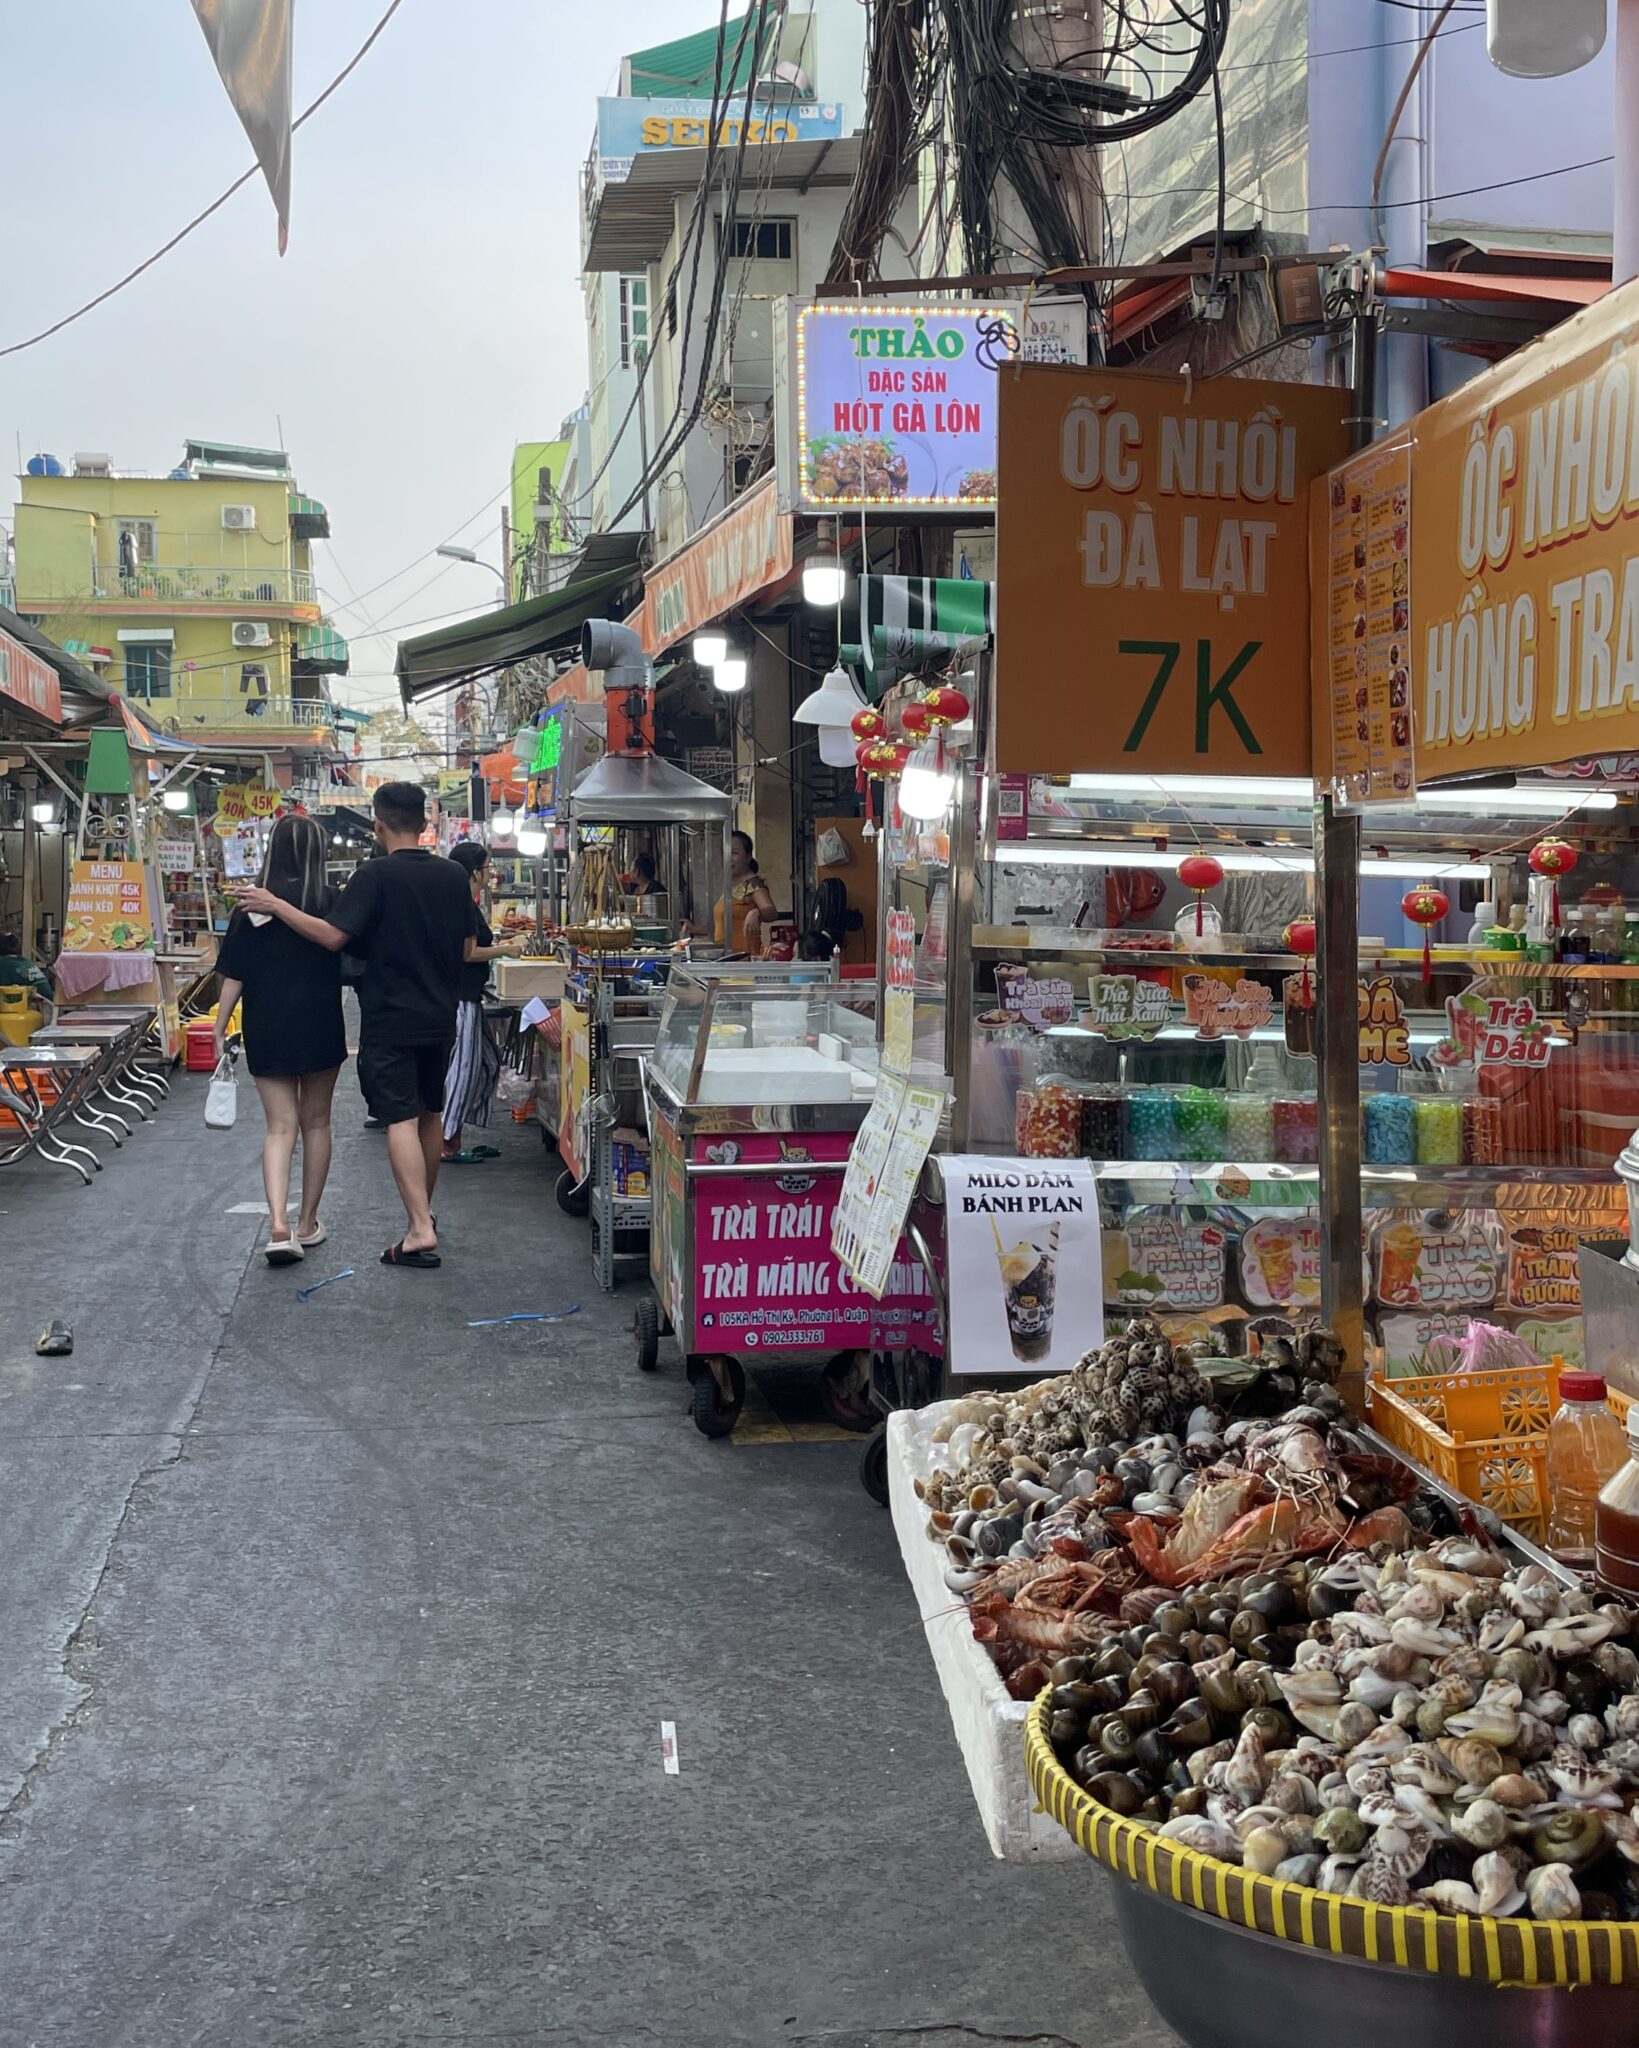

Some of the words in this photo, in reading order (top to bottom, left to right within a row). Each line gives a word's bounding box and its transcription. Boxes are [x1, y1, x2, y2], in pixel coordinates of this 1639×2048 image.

[850, 317, 964, 359] THẢO
[868, 367, 905, 397] ĐẶC
[912, 366, 947, 393] SẢN
[834, 397, 884, 438] HỘT
[893, 399, 926, 433] GÀ
[935, 398, 980, 439] LỘN
[1062, 394, 1141, 493] ỐC
[1159, 405, 1297, 502] NHỒI
[1459, 402, 1515, 571] ỐC
[1080, 500, 1162, 588] ĐÀ
[1182, 515, 1278, 611] LẠT
[1424, 583, 1536, 745] HỒNG
[1118, 639, 1263, 754] 7K
[223, 801, 247, 819] 40K
[251, 795, 274, 810] 45K
[91, 865, 123, 879] MENU
[121, 884, 140, 896] 45K
[121, 901, 140, 914] 40K
[1005, 978, 1037, 996] Trà
[1040, 977, 1073, 995] Sữa
[1099, 983, 1132, 1005] Trà
[1134, 983, 1173, 1003] Sữa
[1488, 1000, 1534, 1028] Trà
[967, 1173, 1021, 1188] MILO
[962, 1193, 1023, 1213] BÁNH
[1028, 1196, 1083, 1213] PLAN
[711, 1199, 757, 1241] TRÀ
[766, 1198, 823, 1239] TRÁI
[1421, 1225, 1493, 1266] TRÀ
[702, 1257, 749, 1299] TRÀ
[757, 1256, 831, 1297] MÃNG
[1524, 1254, 1571, 1279] TRÂN
[763, 1329, 825, 1346] 0902.333.761
